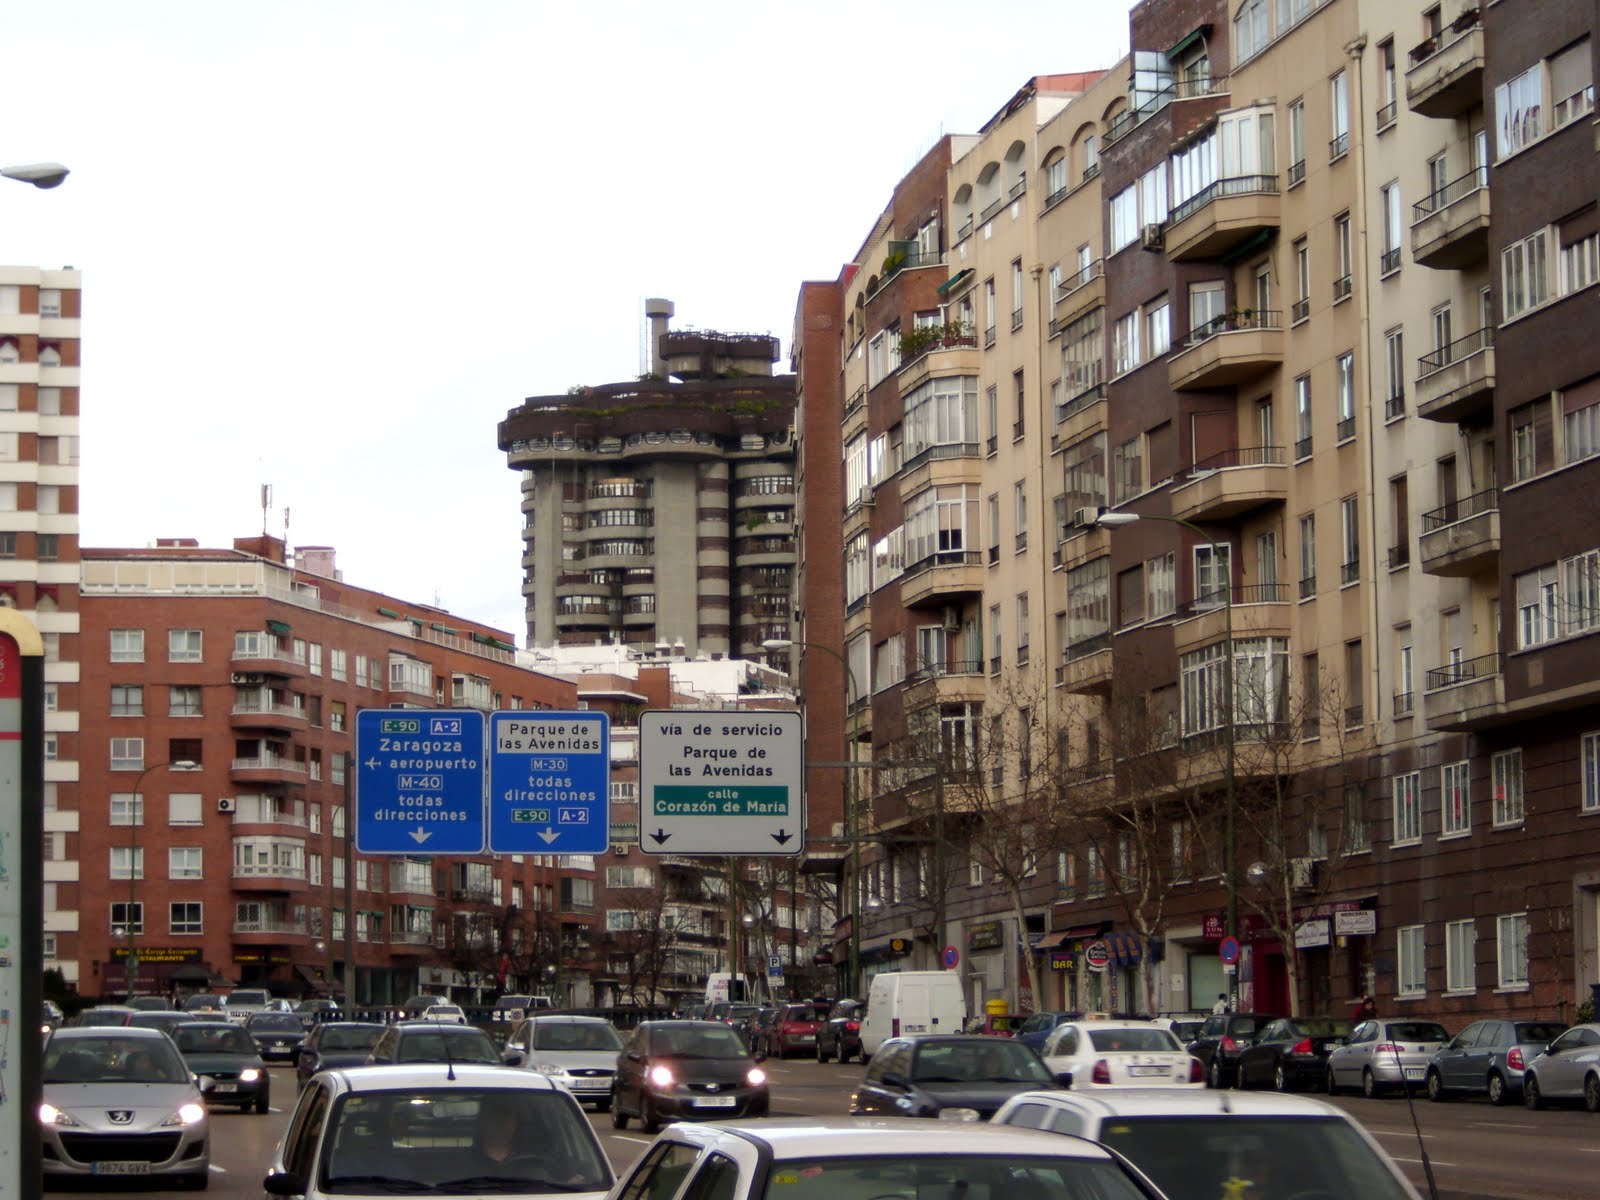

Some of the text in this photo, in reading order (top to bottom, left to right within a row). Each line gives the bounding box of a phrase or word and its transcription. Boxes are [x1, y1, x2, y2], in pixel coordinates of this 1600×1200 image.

[383, 722, 417, 732] E-90
[433, 721, 460, 733] A-2
[510, 724, 589, 739] Parque de
[660, 723, 783, 736] vía de servicio
[379, 738, 463, 755] Zaragoza
[499, 738, 600, 750] las Avenidas
[683, 746, 767, 762] Parque de
[389, 758, 478, 773] aeropuerto
[533, 759, 566, 771] M-30
[669, 764, 774, 777] las Avenidas
[400, 776, 441, 789] M-40
[528, 775, 573, 788] todas
[504, 789, 597, 802] direcciones
[707, 789, 739, 799] calle
[399, 795, 444, 807] todas
[656, 800, 717, 813] Corazón
[723, 801, 741, 813] de
[374, 809, 468, 822] direcciones
[513, 810, 548, 822] E-90
[560, 810, 587, 822] A-2
[1053, 960, 1074, 969] BAR
